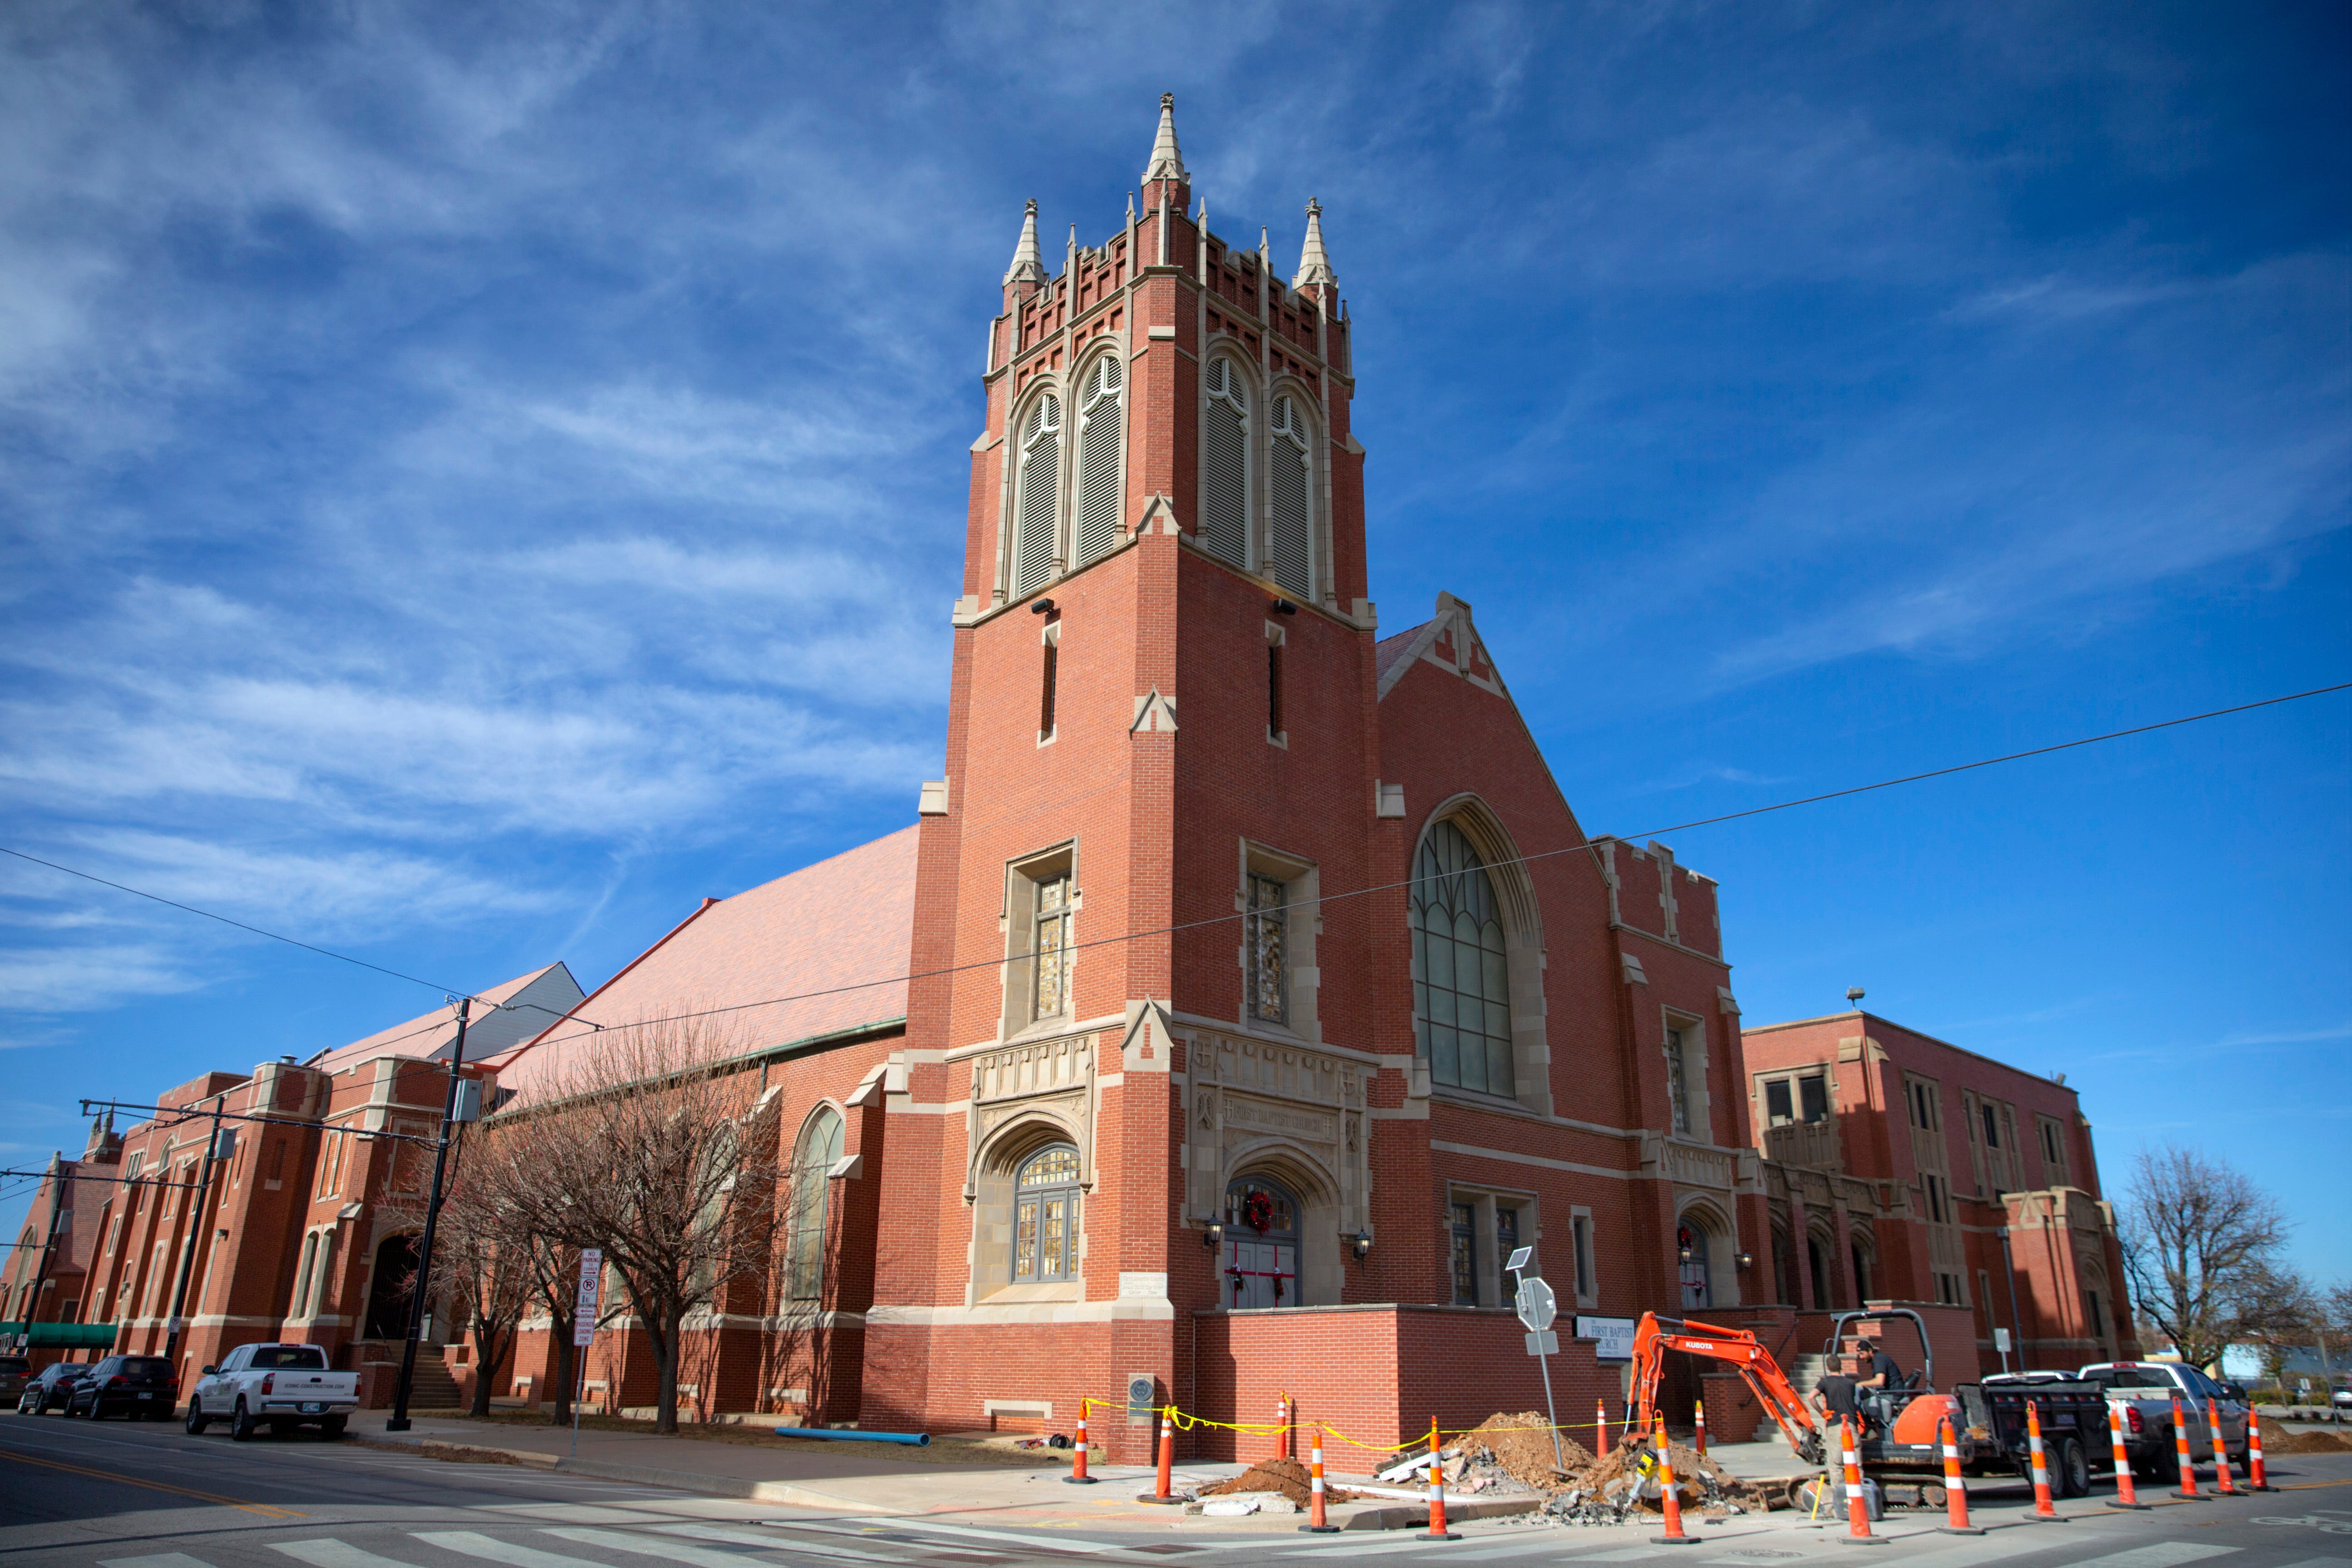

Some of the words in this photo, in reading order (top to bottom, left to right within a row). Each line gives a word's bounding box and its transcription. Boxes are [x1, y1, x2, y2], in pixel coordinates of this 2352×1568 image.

[1234, 1105, 1257, 1121] FIRST
[1259, 1109, 1291, 1127] BAPTIST
[1293, 1115, 1321, 1132] CHURCH
[1591, 1325, 1607, 1337] FIRST
[1609, 1326, 1633, 1338] BAPTIST
[1597, 1338, 1618, 1350] HURCH
[1686, 1342, 1713, 1350] KUBOTA
